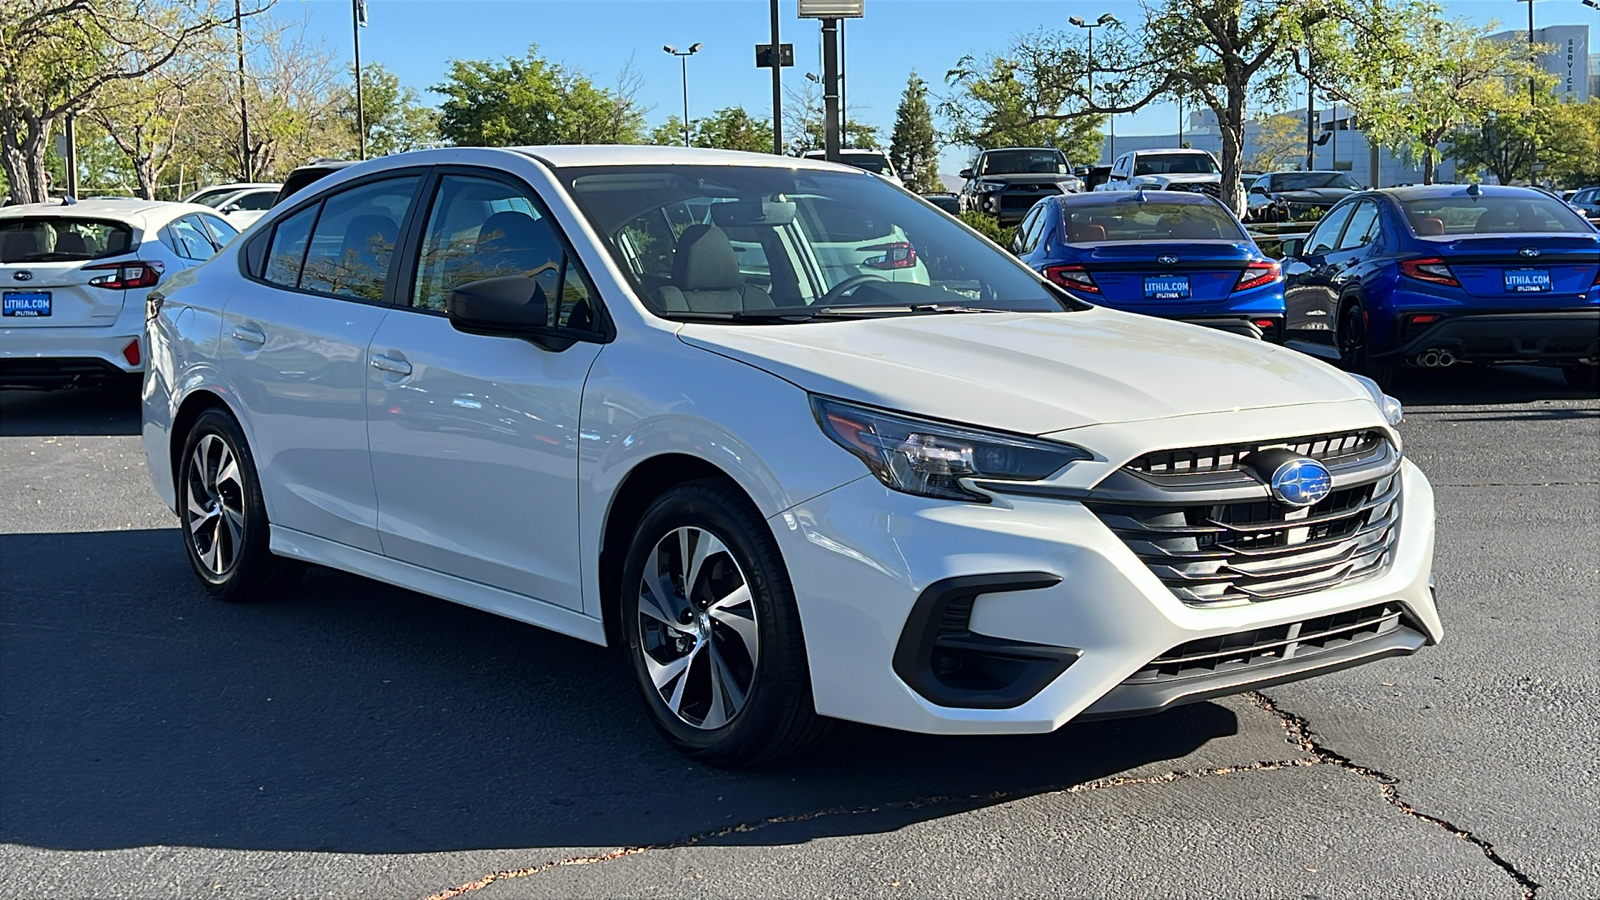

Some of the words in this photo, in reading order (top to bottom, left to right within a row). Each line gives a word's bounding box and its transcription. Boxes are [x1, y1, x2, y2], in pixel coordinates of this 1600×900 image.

[1505, 275, 1550, 285] LITHIA.COM
[1144, 282, 1189, 292] LITHIA.COM
[4, 299, 50, 309] LITHIA.COM
